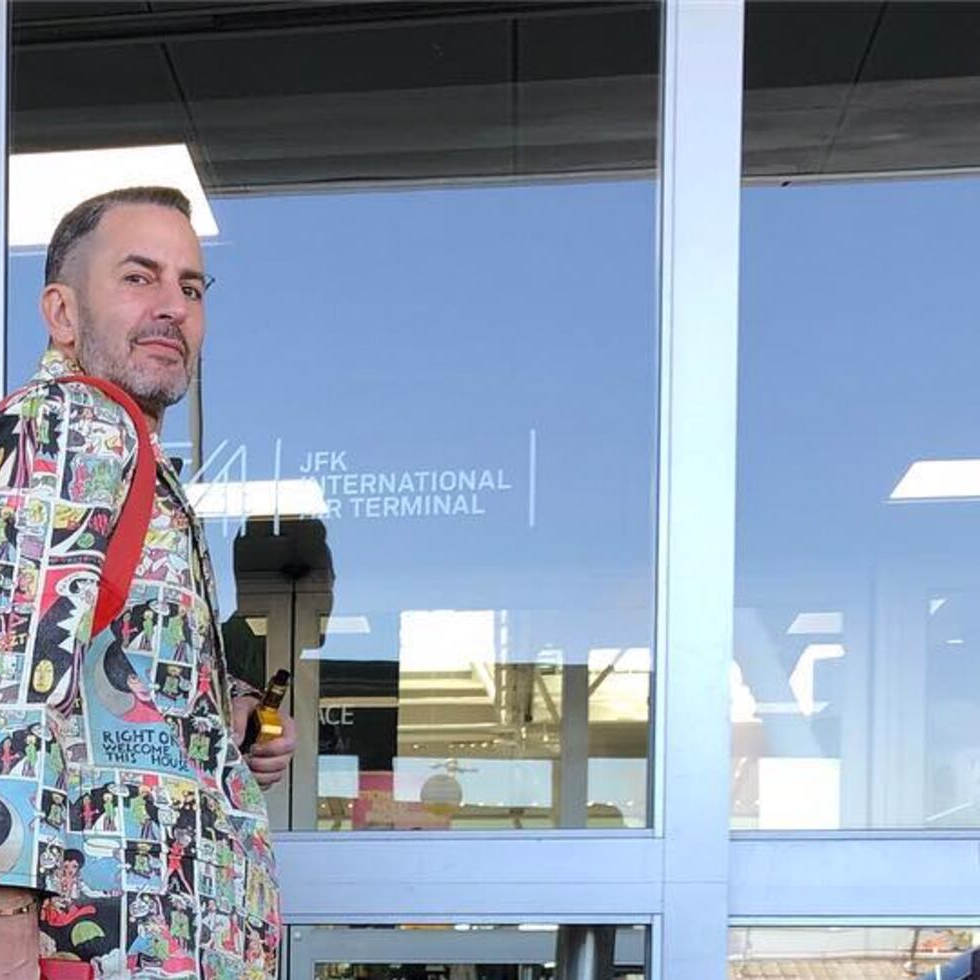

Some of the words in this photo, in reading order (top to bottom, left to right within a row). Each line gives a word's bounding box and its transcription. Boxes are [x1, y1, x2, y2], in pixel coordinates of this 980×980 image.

[299, 450, 348, 473] JFK
[301, 469, 512, 497] NTERNATIONAL
[350, 493, 486, 519] TERMINAL
[102, 729, 155, 744] RIGHT
[102, 743, 171, 755] WELCOME
[107, 752, 137, 764] THIS
